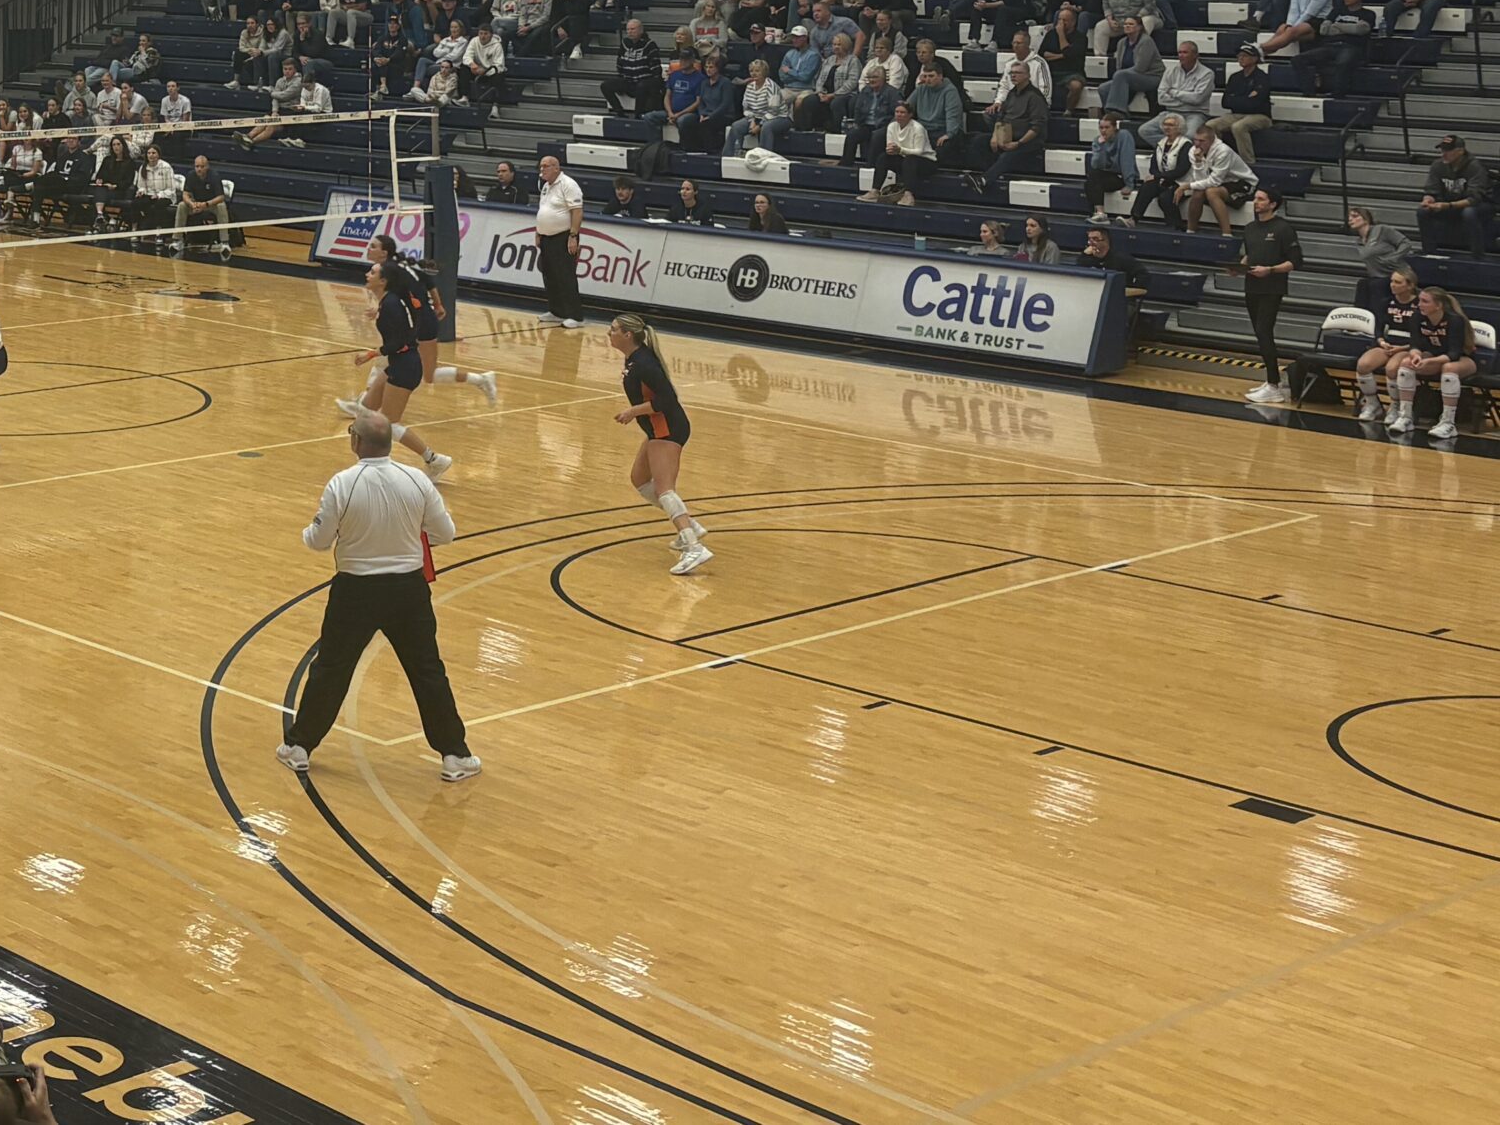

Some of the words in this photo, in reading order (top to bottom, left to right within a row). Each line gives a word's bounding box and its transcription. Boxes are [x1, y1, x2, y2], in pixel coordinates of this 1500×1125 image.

[0, 130, 32, 138] CONCORDIA
[67, 127, 97, 135] CONCORDIA
[131, 124, 160, 132] CONCORDIA
[254, 116, 281, 124] CONCORDIA
[312, 113, 340, 121] CONCORDIA
[63, 160, 73, 172] C
[664, 261, 728, 283] HUGHES
[735, 267, 759, 288] HB
[768, 273, 857, 299] BROTHERS
[902, 265, 1055, 333] Cattle
[914, 325, 957, 341] BANK
[960, 331, 969, 342] &
[974, 332, 1025, 350] TRUST
